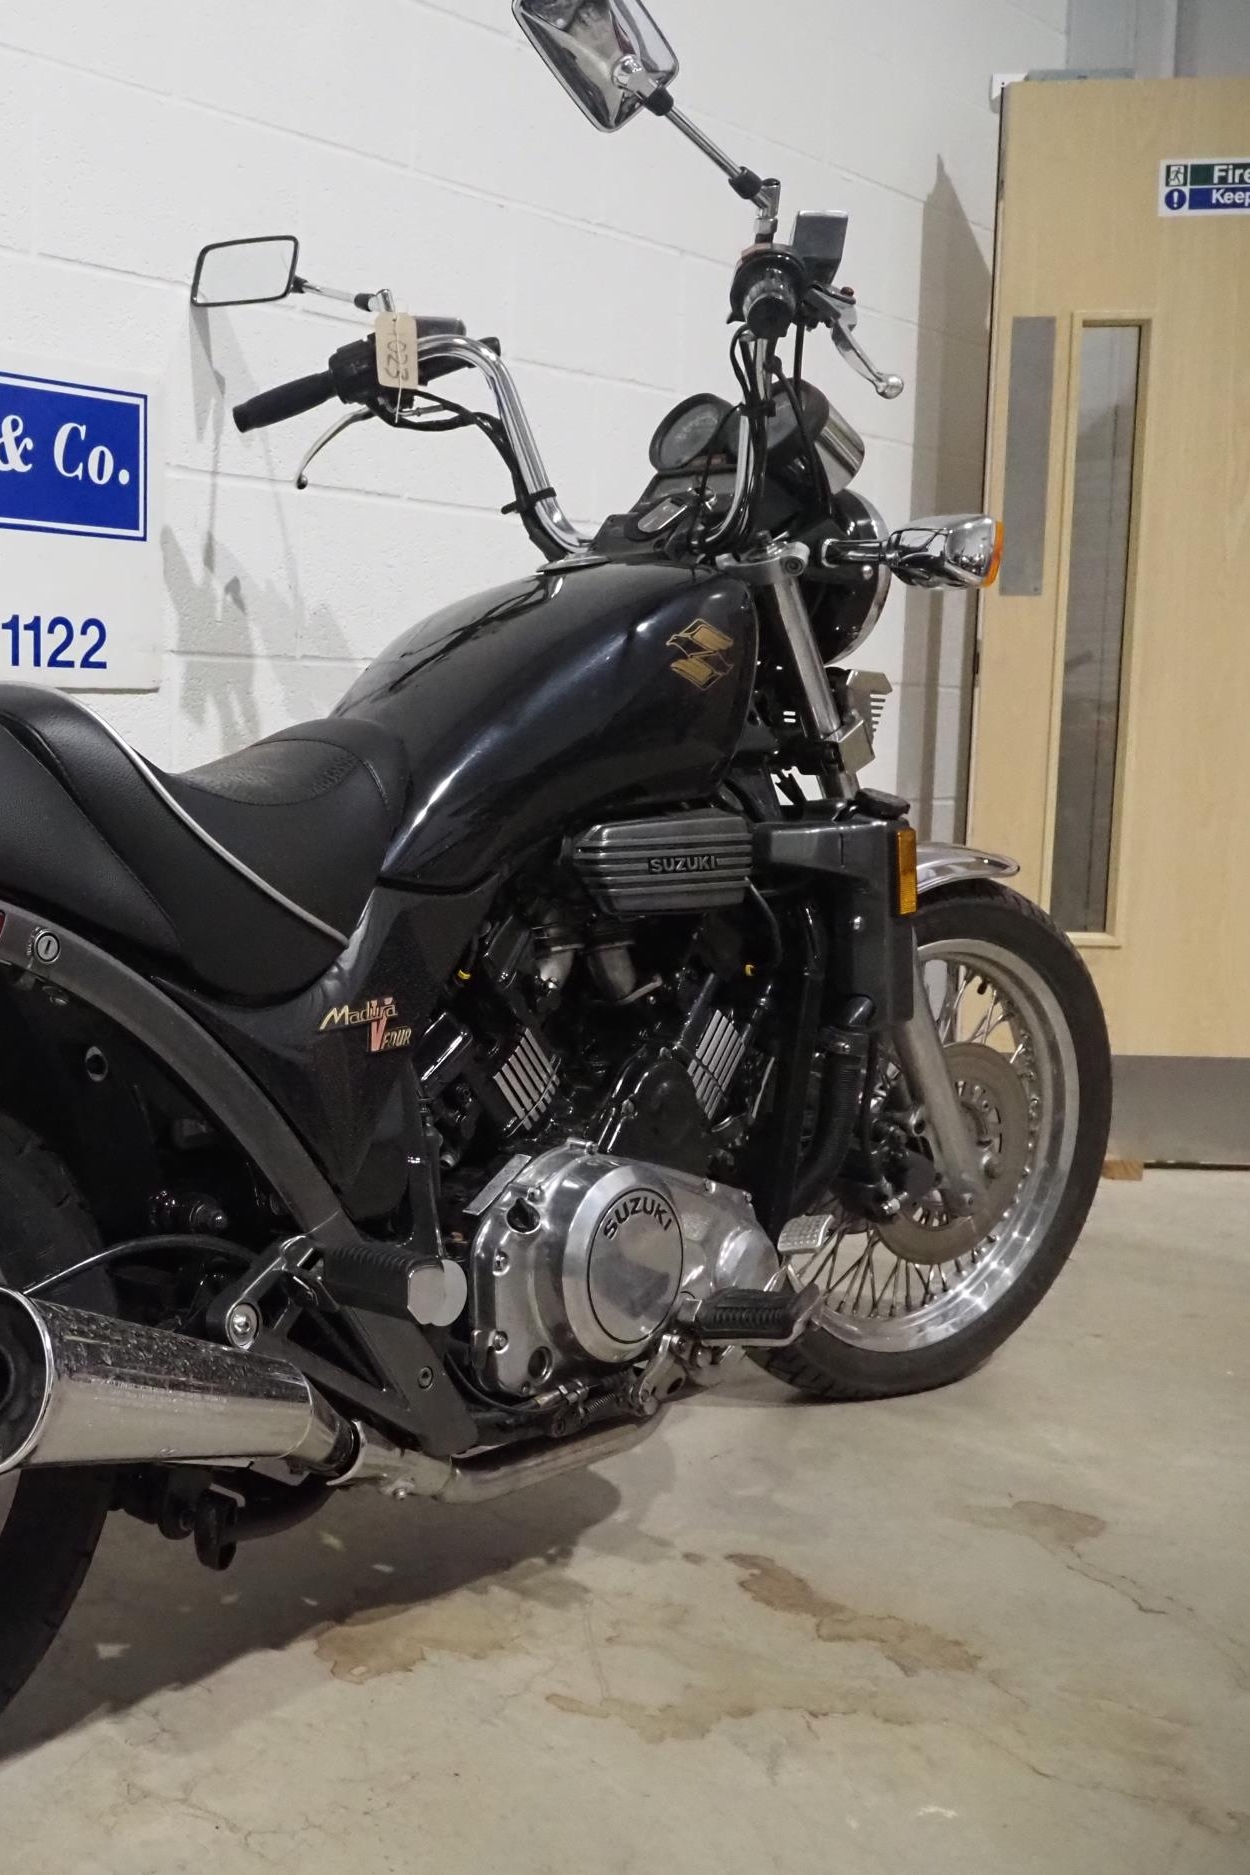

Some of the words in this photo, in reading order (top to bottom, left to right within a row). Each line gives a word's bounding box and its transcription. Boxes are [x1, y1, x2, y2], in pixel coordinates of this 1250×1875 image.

[53, 422, 130, 485] Co.
[650, 855, 716, 873] SUZUKI
[319, 1000, 398, 1031] Madura
[603, 1196, 672, 1240] SUZUKI
